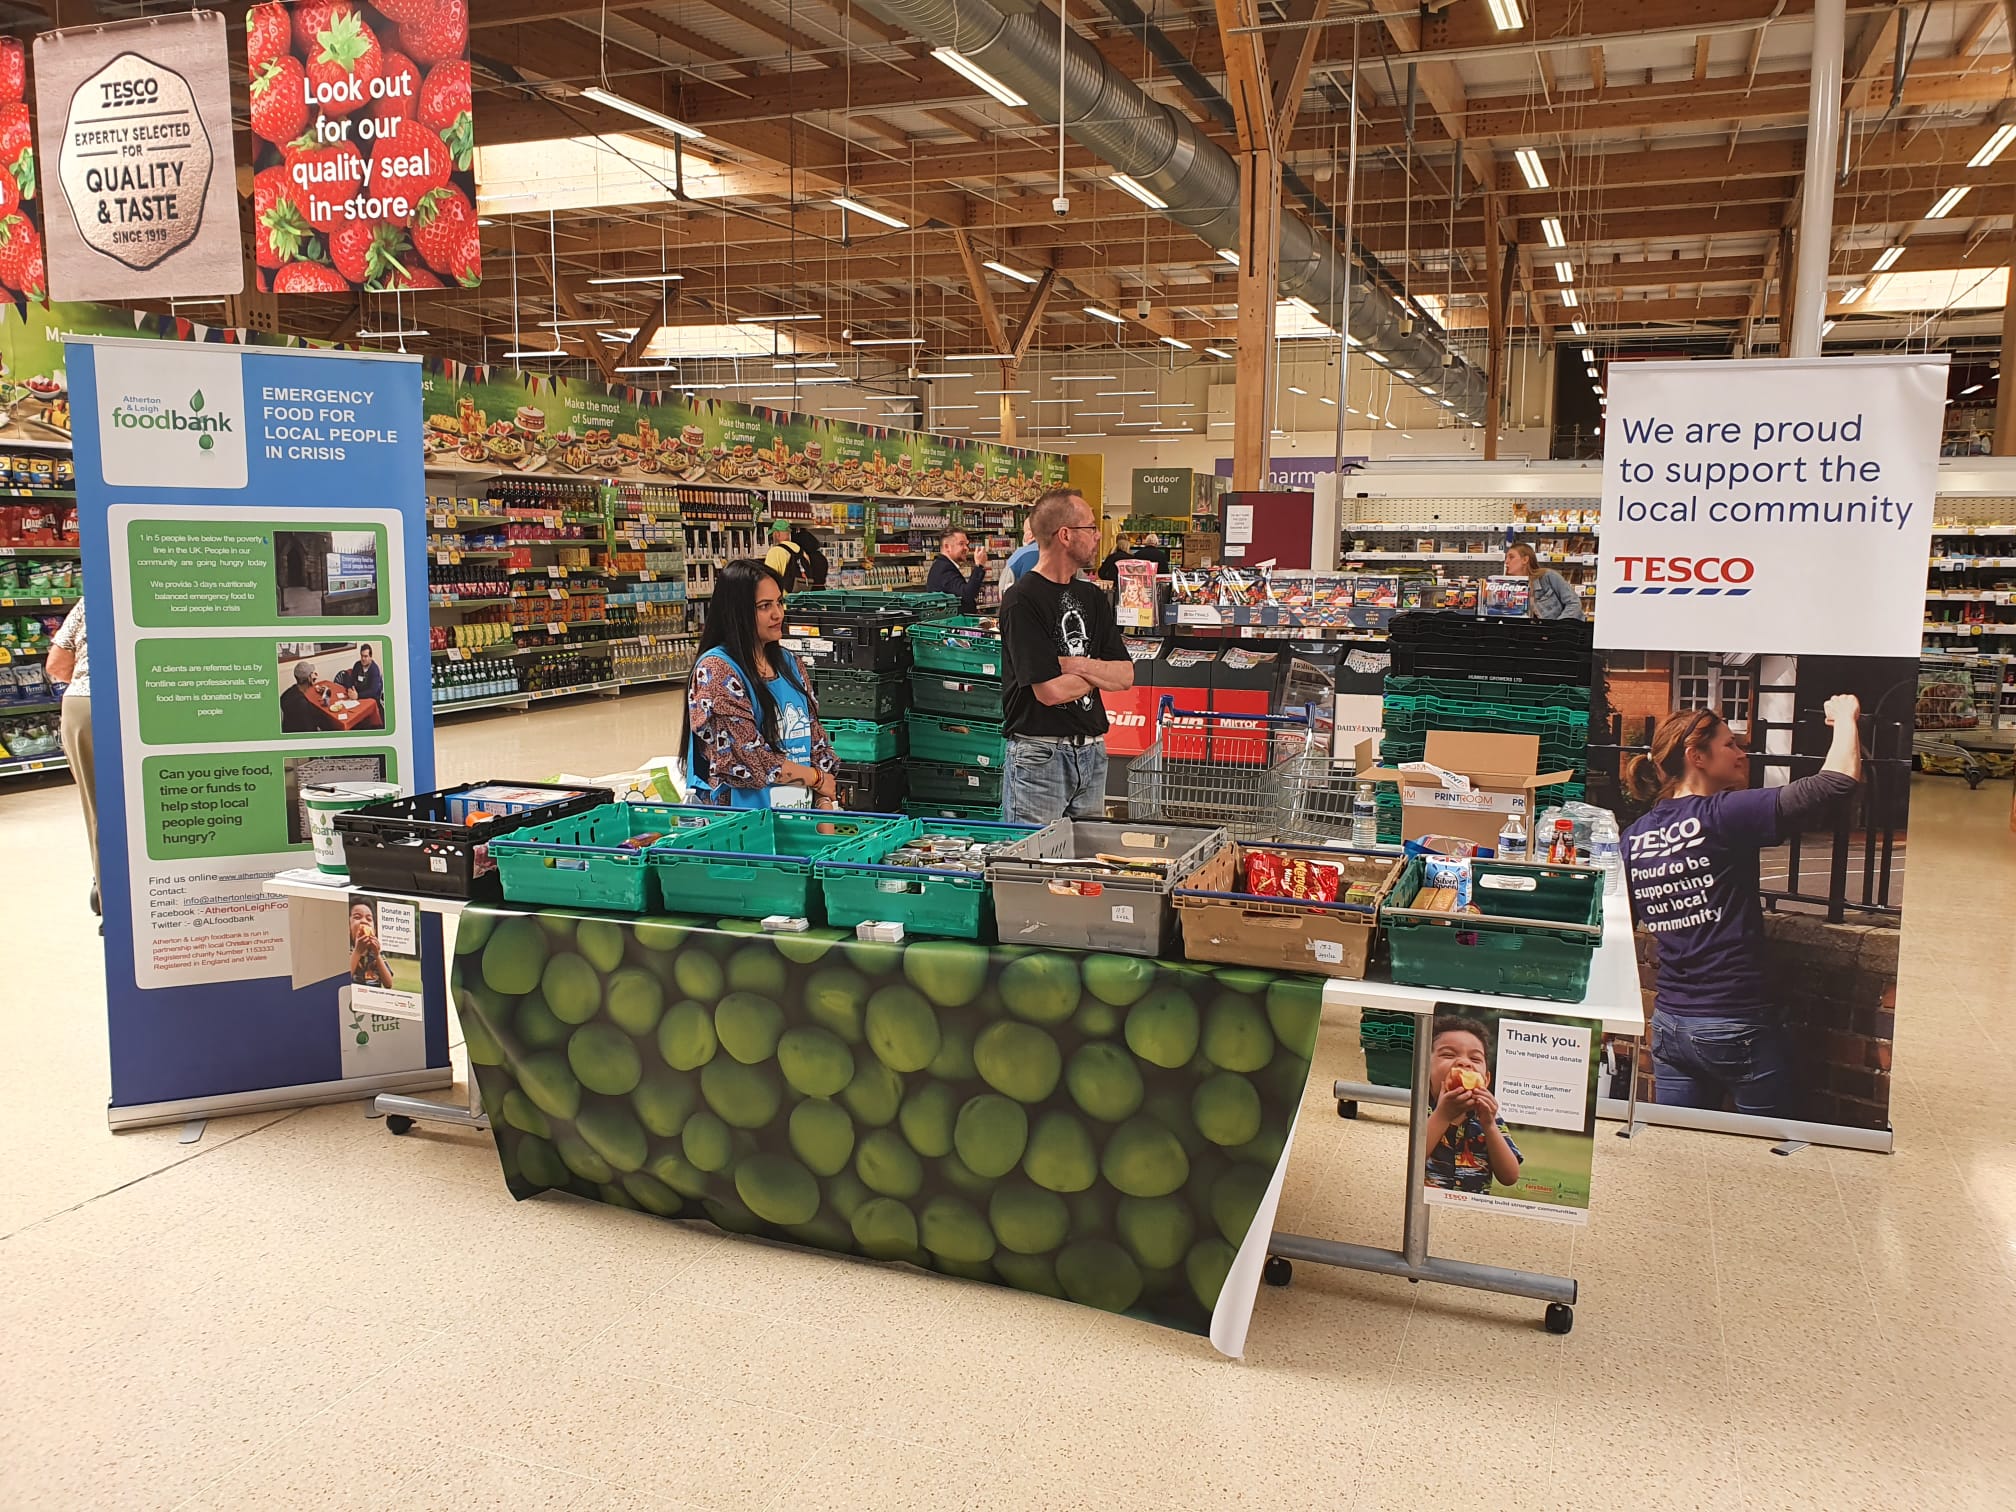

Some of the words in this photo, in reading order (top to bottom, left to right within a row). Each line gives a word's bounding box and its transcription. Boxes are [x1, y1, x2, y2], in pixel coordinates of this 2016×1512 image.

[100, 77, 159, 101] TESCO
[303, 73, 362, 105] Look
[369, 71, 412, 99] out
[74, 127, 130, 147] EXPERTLY
[132, 122, 191, 141] SELECTED
[315, 117, 352, 143] for
[357, 114, 401, 140] our
[122, 145, 143, 157] FOR
[293, 152, 372, 188] quality
[380, 148, 430, 177] seal
[86, 161, 184, 193] QUALITY
[97, 206, 113, 224] &
[115, 195, 179, 222] TASTE
[310, 193, 416, 221] in-store.
[112, 229, 143, 244] SINCE
[144, 227, 168, 241] 1919
[123, 395, 161, 404] Atherton
[262, 387, 374, 405] EMERGENCY
[135, 404, 159, 413] Leigh
[564, 396, 585, 410] Make
[586, 399, 599, 411] the
[601, 403, 620, 414] most
[112, 407, 233, 432] foodbank
[263, 407, 313, 422] FOOD
[319, 409, 355, 423] FOR
[572, 414, 582, 424] of
[582, 414, 615, 427] Summer
[718, 416, 733, 428] Make
[735, 419, 744, 429] the
[745, 421, 760, 431] most
[264, 426, 325, 442] LOCAL
[329, 429, 398, 444] PEOPLE
[724, 431, 731, 439] of
[731, 432, 756, 443] Summer
[1622, 417, 1674, 444] We
[1685, 421, 1741, 444] are
[1752, 413, 1863, 450] proud
[265, 446, 283, 459] IN
[287, 446, 346, 461] CRISIS
[1143, 475, 1180, 484] Outdoor
[1620, 458, 1654, 483] to
[1665, 456, 1807, 490] support
[1820, 455, 1881, 483] the
[1152, 485, 1169, 494] Life
[1617, 495, 1697, 522] local
[1708, 495, 1913, 530] community
[1614, 556, 1755, 584] TESCO
[151, 665, 161, 673] All
[162, 665, 188, 673] clients
[203, 664, 232, 672] referred
[253, 664, 262, 672] by
[145, 680, 176, 688] frontline
[248, 677, 270, 686] Every
[156, 694, 174, 702] food
[201, 693, 232, 701] donated
[233, 693, 243, 701] by
[244, 692, 261, 700] local
[197, 708, 224, 717] people
[1106, 711, 1146, 727] Sun
[1220, 719, 1258, 729] Mirror
[159, 769, 185, 780] Can
[187, 769, 211, 781] you
[214, 767, 240, 779] give
[242, 765, 273, 777] food,
[160, 785, 188, 796] time
[190, 784, 204, 795] or
[206, 782, 242, 793] funds
[244, 781, 256, 792] to
[161, 801, 189, 813] help
[191, 798, 218, 811] stop
[220, 798, 249, 808] local
[1434, 792, 1493, 805] PRINTROOM
[162, 815, 205, 830] people
[207, 815, 243, 827] going
[163, 831, 216, 845] hungry?
[1629, 817, 1701, 852] TESCO
[1631, 862, 1666, 883] Proud
[1668, 862, 1684, 875] to
[1685, 856, 1711, 870] be
[149, 876, 171, 885] Find
[173, 875, 186, 883] us
[188, 873, 218, 882] online
[1634, 873, 1714, 900] supporting
[1646, 902, 1669, 915] our
[1669, 890, 1708, 911] local
[151, 909, 195, 918] Facebook
[381, 907, 402, 916] Donate
[1644, 906, 1722, 932] ommunity
[152, 921, 182, 929] Twitter
[193, 915, 254, 927] @ALfoodbank
[153, 945, 192, 954] partnership
[253, 937, 284, 945] churches
[153, 953, 191, 963] Registered
[216, 948, 244, 956] Number
[153, 962, 192, 971] Registered
[201, 958, 230, 967] England
[372, 1021, 400, 1032] trust
[1506, 1029, 1547, 1044] Thank
[1552, 1036, 1580, 1048] you.
[1527, 1052, 1549, 1060] helped
[1520, 1090, 1556, 1099] Collection.
[1544, 1085, 1571, 1093] Summer
[1444, 1193, 1467, 1201] TESCO
[1471, 1196, 1493, 1205] Helping
[1495, 1199, 1510, 1207] build
[1511, 1202, 1536, 1210] stronger
[1538, 1206, 1577, 1215] communities
